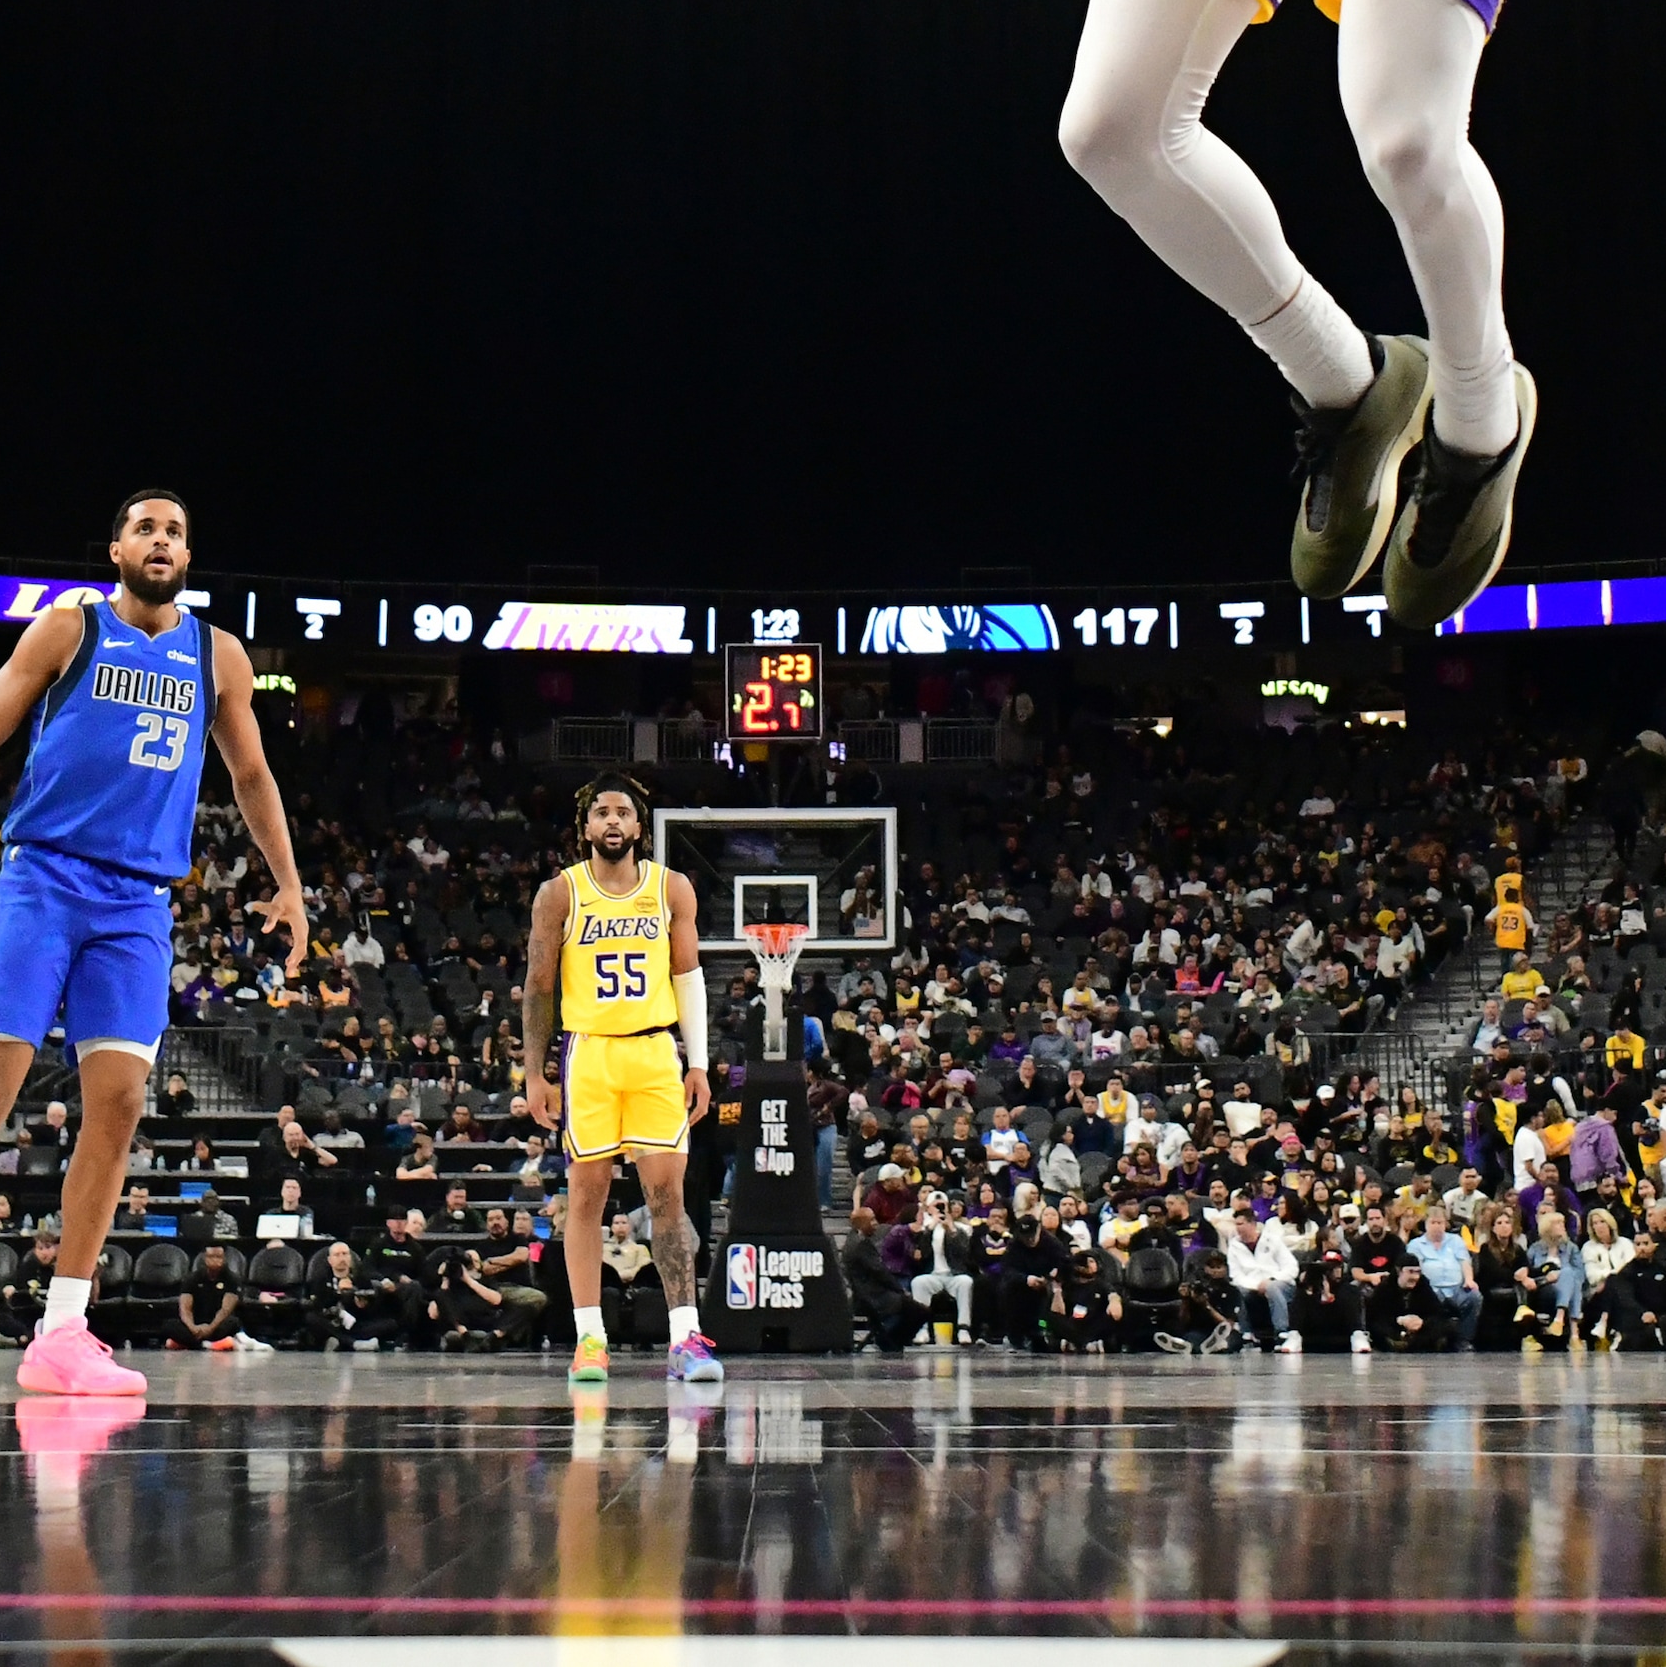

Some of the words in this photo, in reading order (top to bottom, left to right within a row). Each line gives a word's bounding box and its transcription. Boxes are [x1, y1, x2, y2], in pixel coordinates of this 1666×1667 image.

[304, 614, 324, 640] 2
[413, 604, 473, 642] 90
[751, 608, 800, 639] 1:23
[1073, 607, 1159, 645] 117
[1234, 618, 1254, 645] 2
[1366, 611, 1382, 638] 1
[167, 648, 197, 665] chime
[761, 653, 814, 682] 1:23
[91, 663, 197, 714] DALLAS
[129, 712, 190, 772] 23
[577, 914, 660, 945] LAKERS
[1501, 916, 1520, 931] 23
[595, 952, 647, 1000] 55
[760, 1099, 788, 1122] GET
[760, 1122, 789, 1146] THE
[767, 1147, 795, 1176] App
[758, 1245, 824, 1282] League
[758, 1276, 805, 1309] Pass
